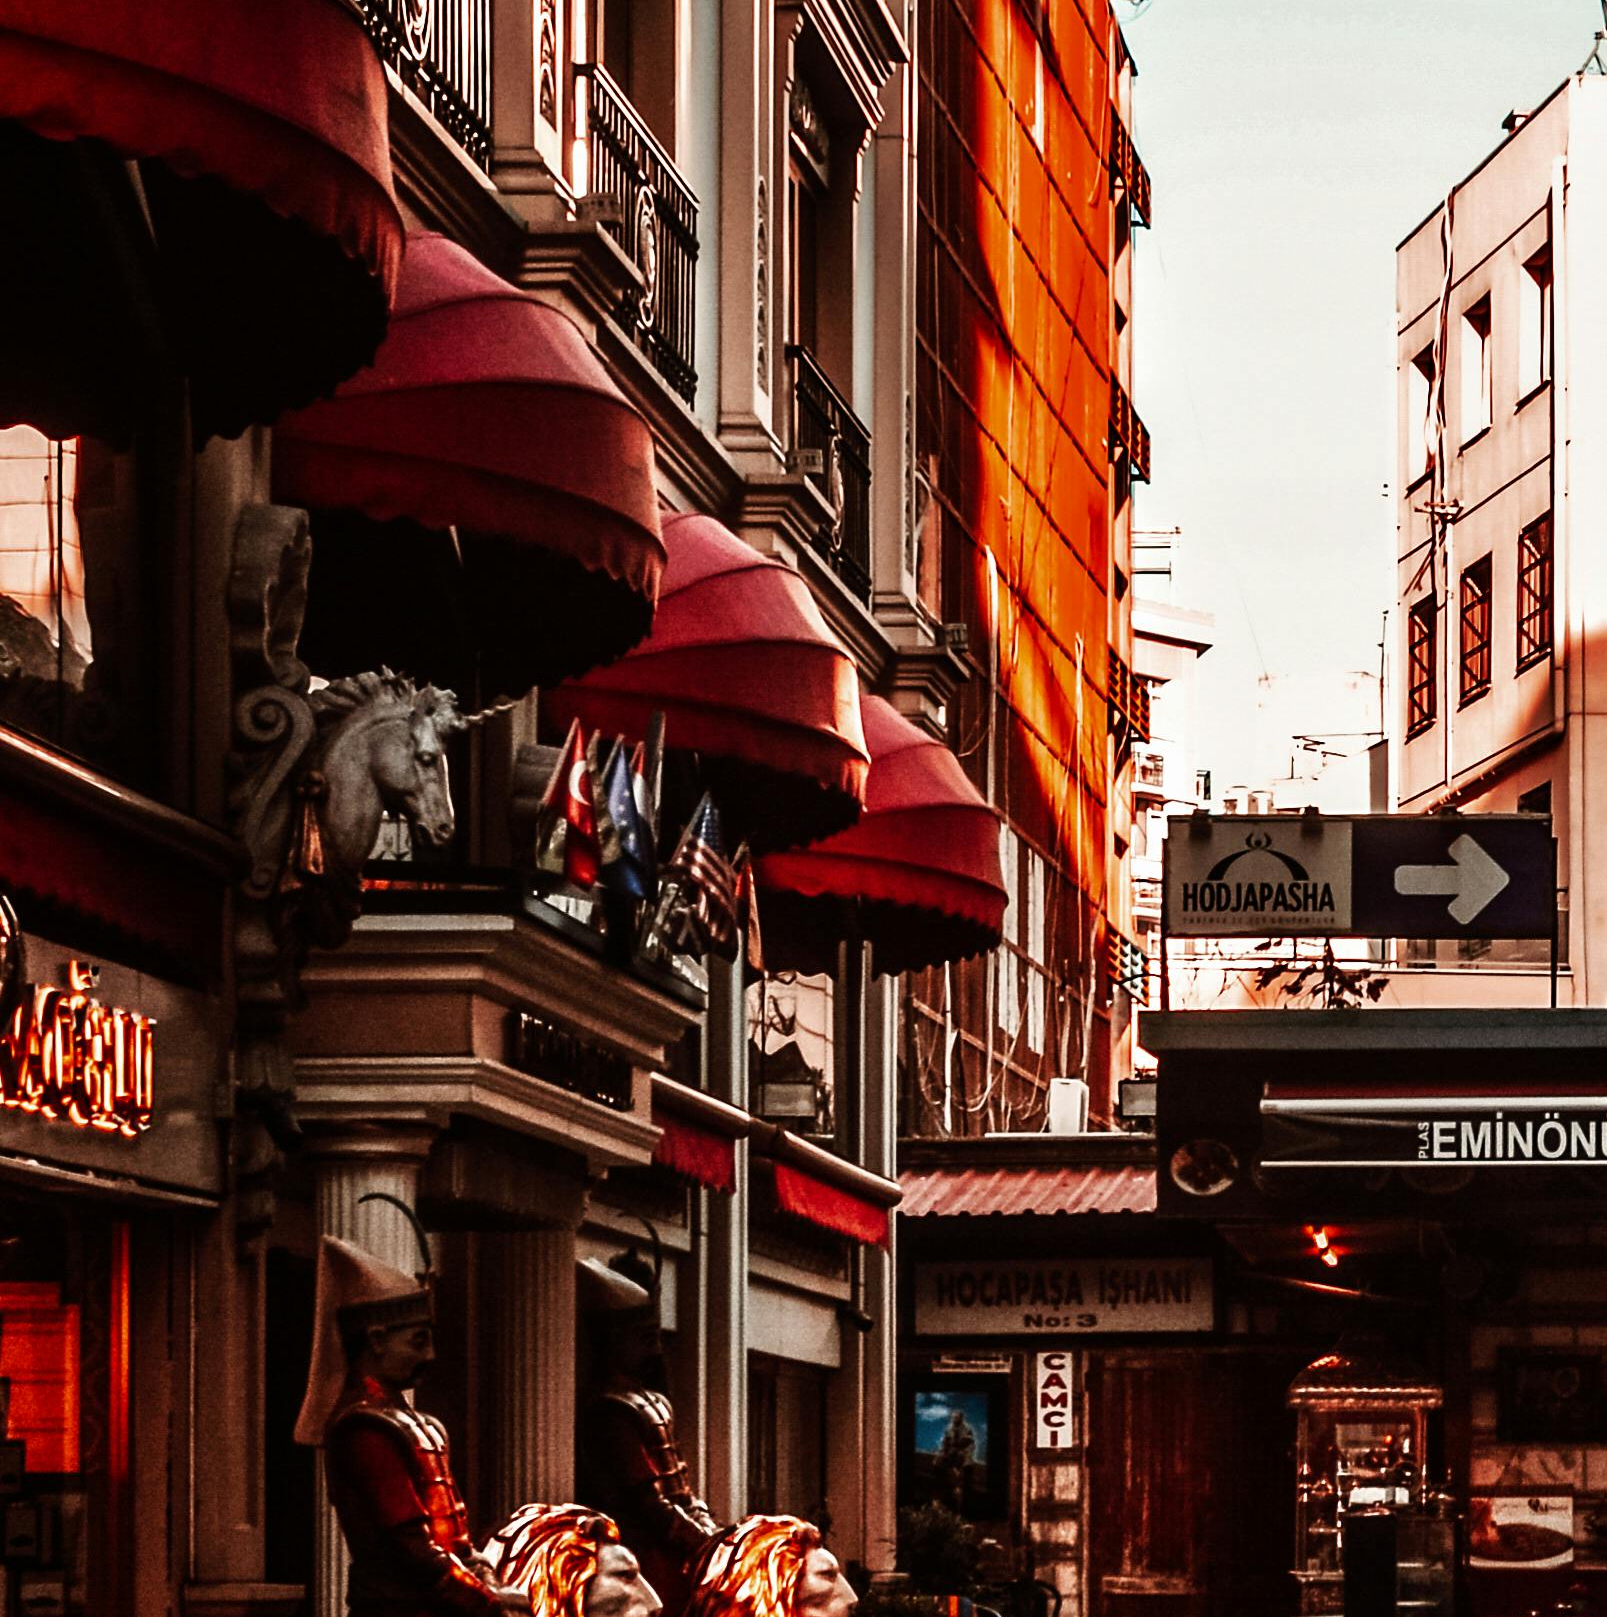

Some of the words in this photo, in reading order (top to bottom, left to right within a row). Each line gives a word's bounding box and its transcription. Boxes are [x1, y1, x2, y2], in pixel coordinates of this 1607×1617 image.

[1183, 883, 1335, 912] HODJAPASHA
[1077, 1314, 1098, 1328] 3
[1040, 1354, 1069, 1447] CAMCI
